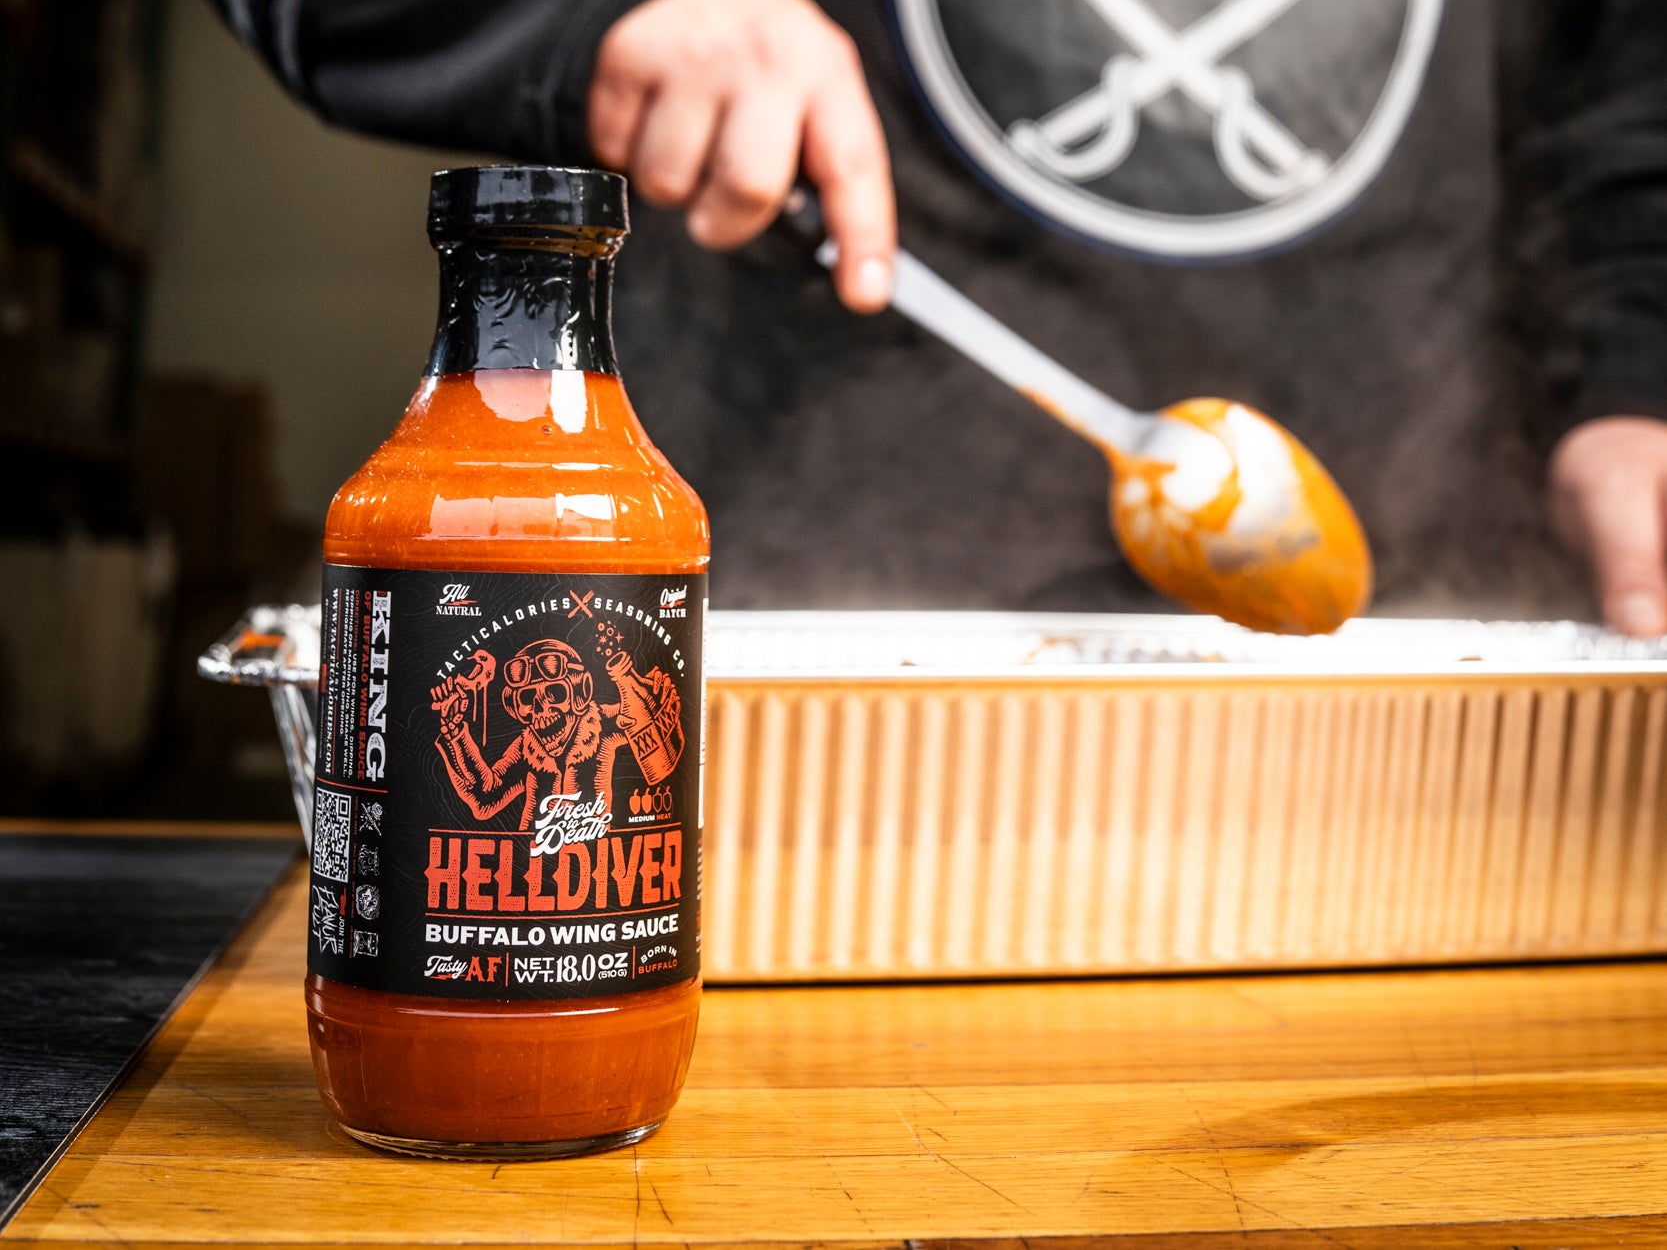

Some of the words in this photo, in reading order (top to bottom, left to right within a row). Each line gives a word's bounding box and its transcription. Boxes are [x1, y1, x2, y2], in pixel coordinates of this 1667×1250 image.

[364, 591, 371, 610] OF
[439, 584, 471, 605] All
[660, 585, 688, 608] Original
[436, 605, 482, 616] NATURAL
[659, 609, 687, 618] BATCH
[348, 634, 353, 648] OR
[361, 615, 371, 682] BUFFALO
[437, 597, 571, 679] TACTICALORIES
[594, 597, 671, 646] SEASONING
[673, 649, 685, 678] CO.
[325, 588, 339, 774] WWW.TACTICALORIES.COM
[366, 590, 391, 782] KING
[360, 687, 368, 727] WING
[633, 728, 658, 757] XXX
[358, 731, 366, 780] SAUCE
[535, 791, 607, 829] Fresh
[628, 814, 655, 823] MEDIUM
[656, 813, 671, 821] HEAT
[530, 813, 613, 857] Death
[567, 817, 579, 829] to
[424, 830, 682, 911] HELLDIVER
[425, 923, 546, 946] BUFFALO
[550, 924, 616, 945] WING
[621, 913, 679, 940] SAUCE
[514, 958, 554, 970] NET
[597, 952, 629, 970] OZ
[638, 959, 678, 974] BUFFALO
[640, 945, 667, 963] BORN
[668, 946, 677, 957] IN
[424, 955, 469, 979] Tasty
[465, 956, 502, 982] AF
[514, 970, 554, 983] WT.
[556, 953, 596, 982] 18.0
